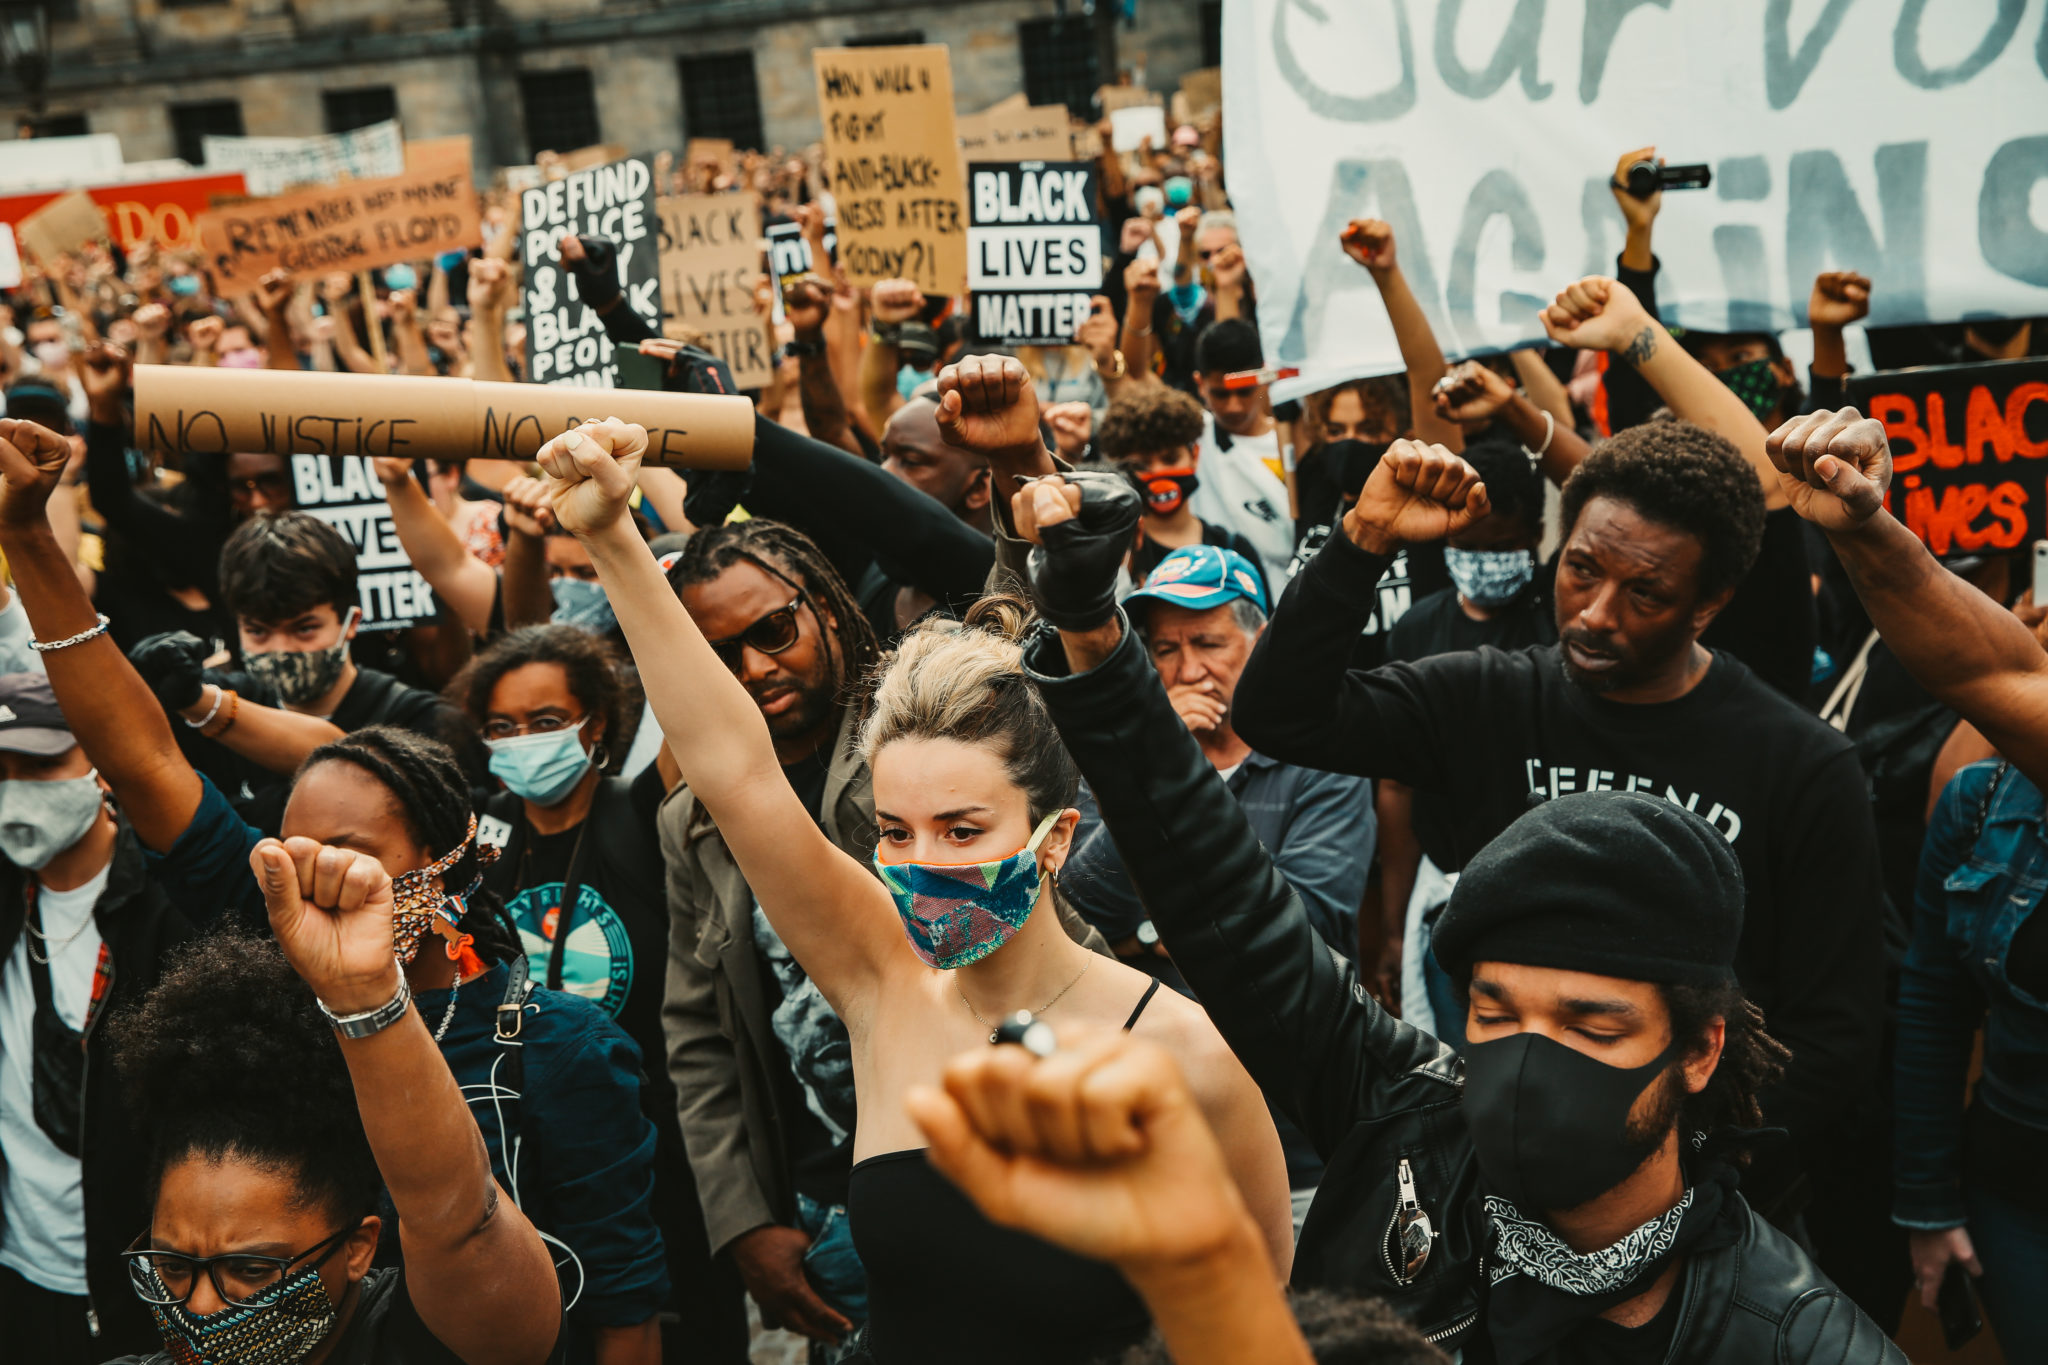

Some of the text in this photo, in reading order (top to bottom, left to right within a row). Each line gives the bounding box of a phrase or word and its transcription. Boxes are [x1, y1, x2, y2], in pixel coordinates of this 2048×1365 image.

[869, 63, 914, 94] WILL
[523, 159, 650, 230] DEFUND
[974, 170, 1091, 222] BLACK
[373, 211, 463, 252] FLOYD
[897, 199, 964, 234] AFTER
[981, 239, 1087, 276] LIVES
[149, 409, 229, 450] NO
[482, 406, 545, 459] NO
